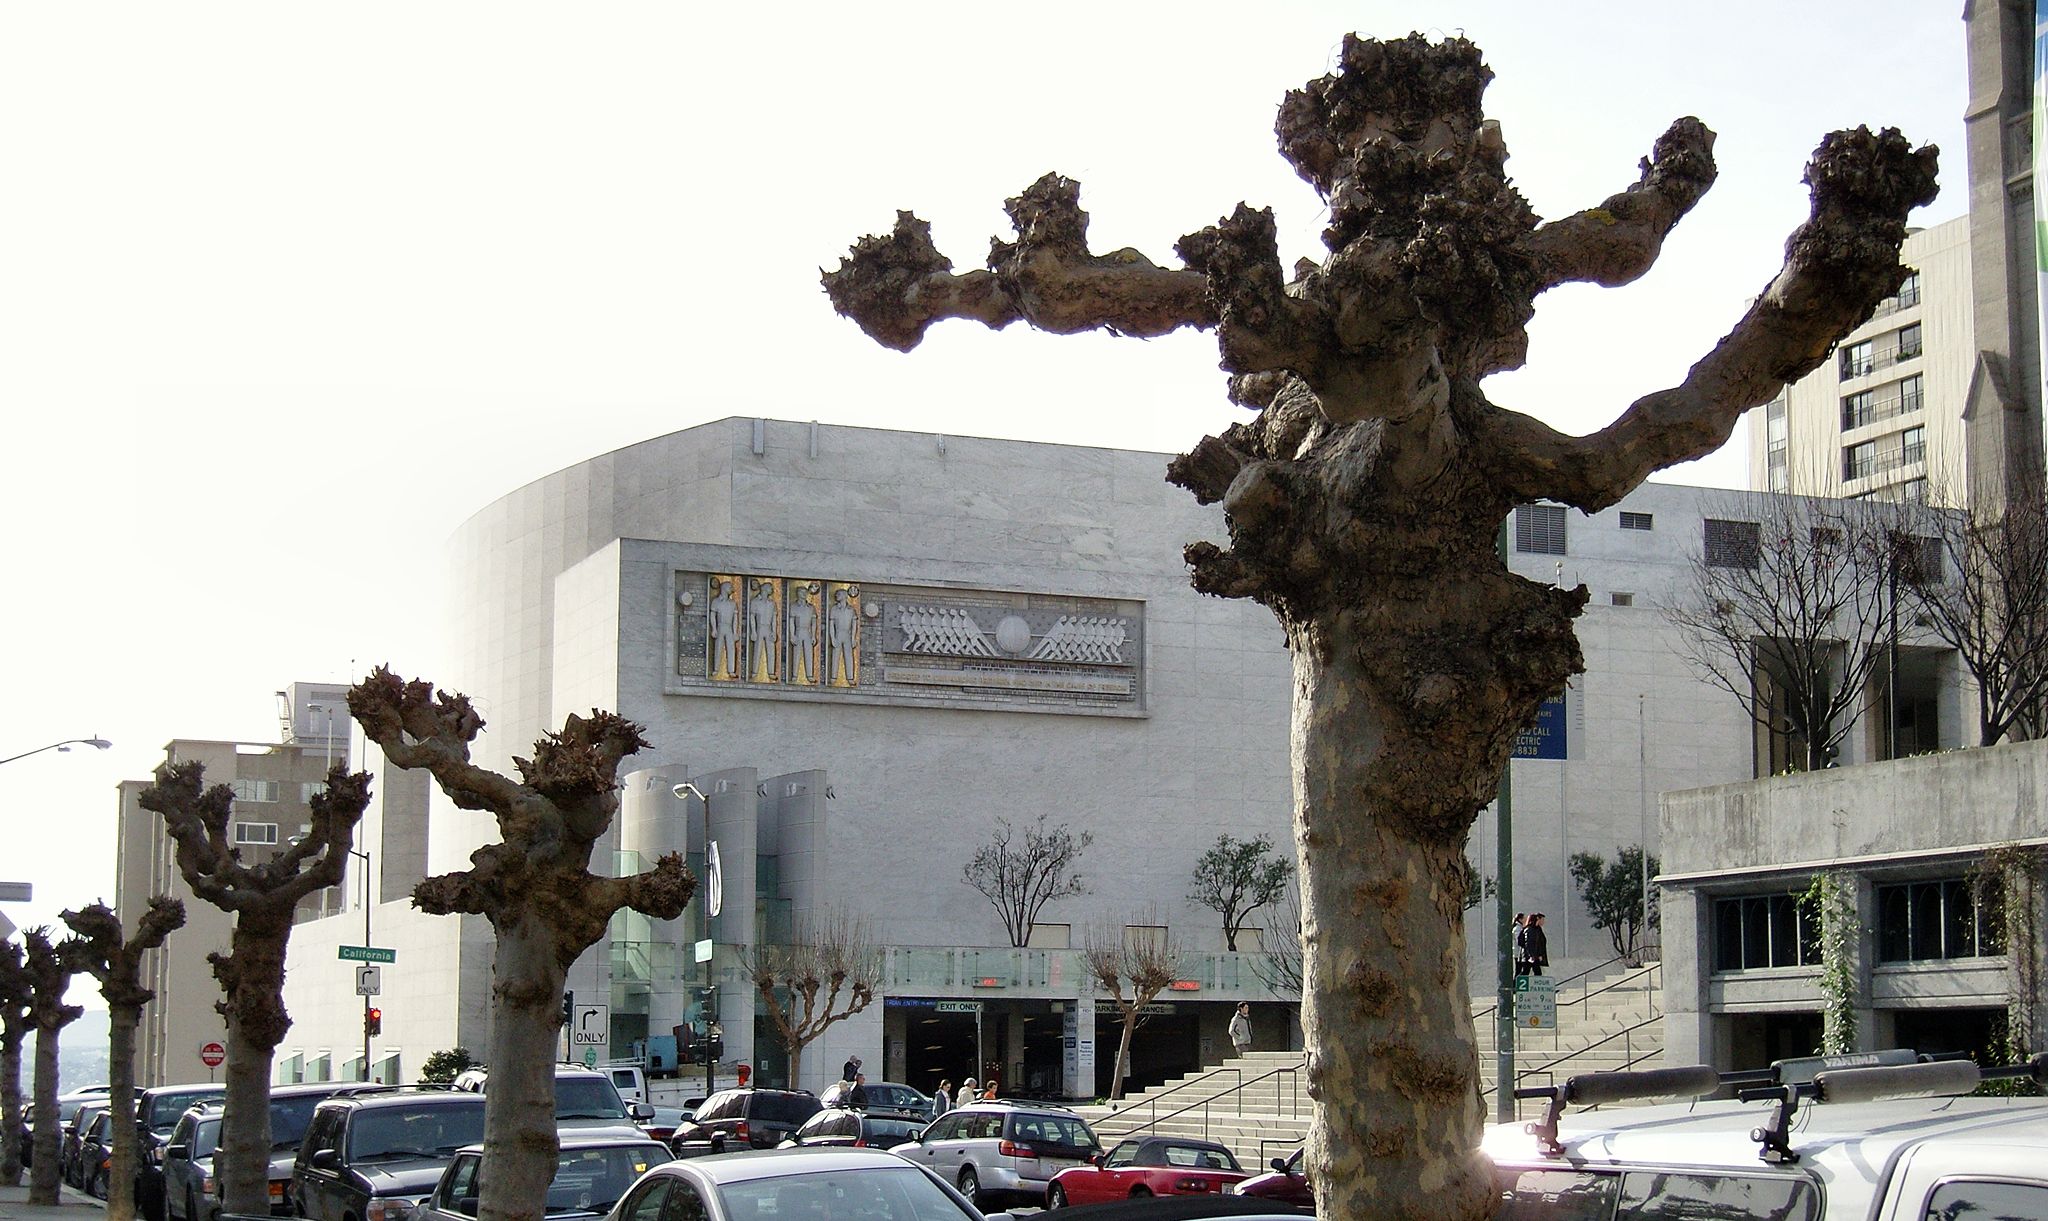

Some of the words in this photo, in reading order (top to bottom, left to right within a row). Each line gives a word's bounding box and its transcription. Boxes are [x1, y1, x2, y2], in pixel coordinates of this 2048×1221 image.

[1533, 727, 1551, 736] CALL
[343, 949, 391, 960] California
[358, 986, 379, 994] ONLY
[1519, 979, 1527, 990] 2
[940, 1003, 956, 1011] EXIT
[959, 1003, 978, 1011] ONLY
[576, 1032, 605, 1043] ONLY
[1823, 1054, 1880, 1067] YAKIMA
